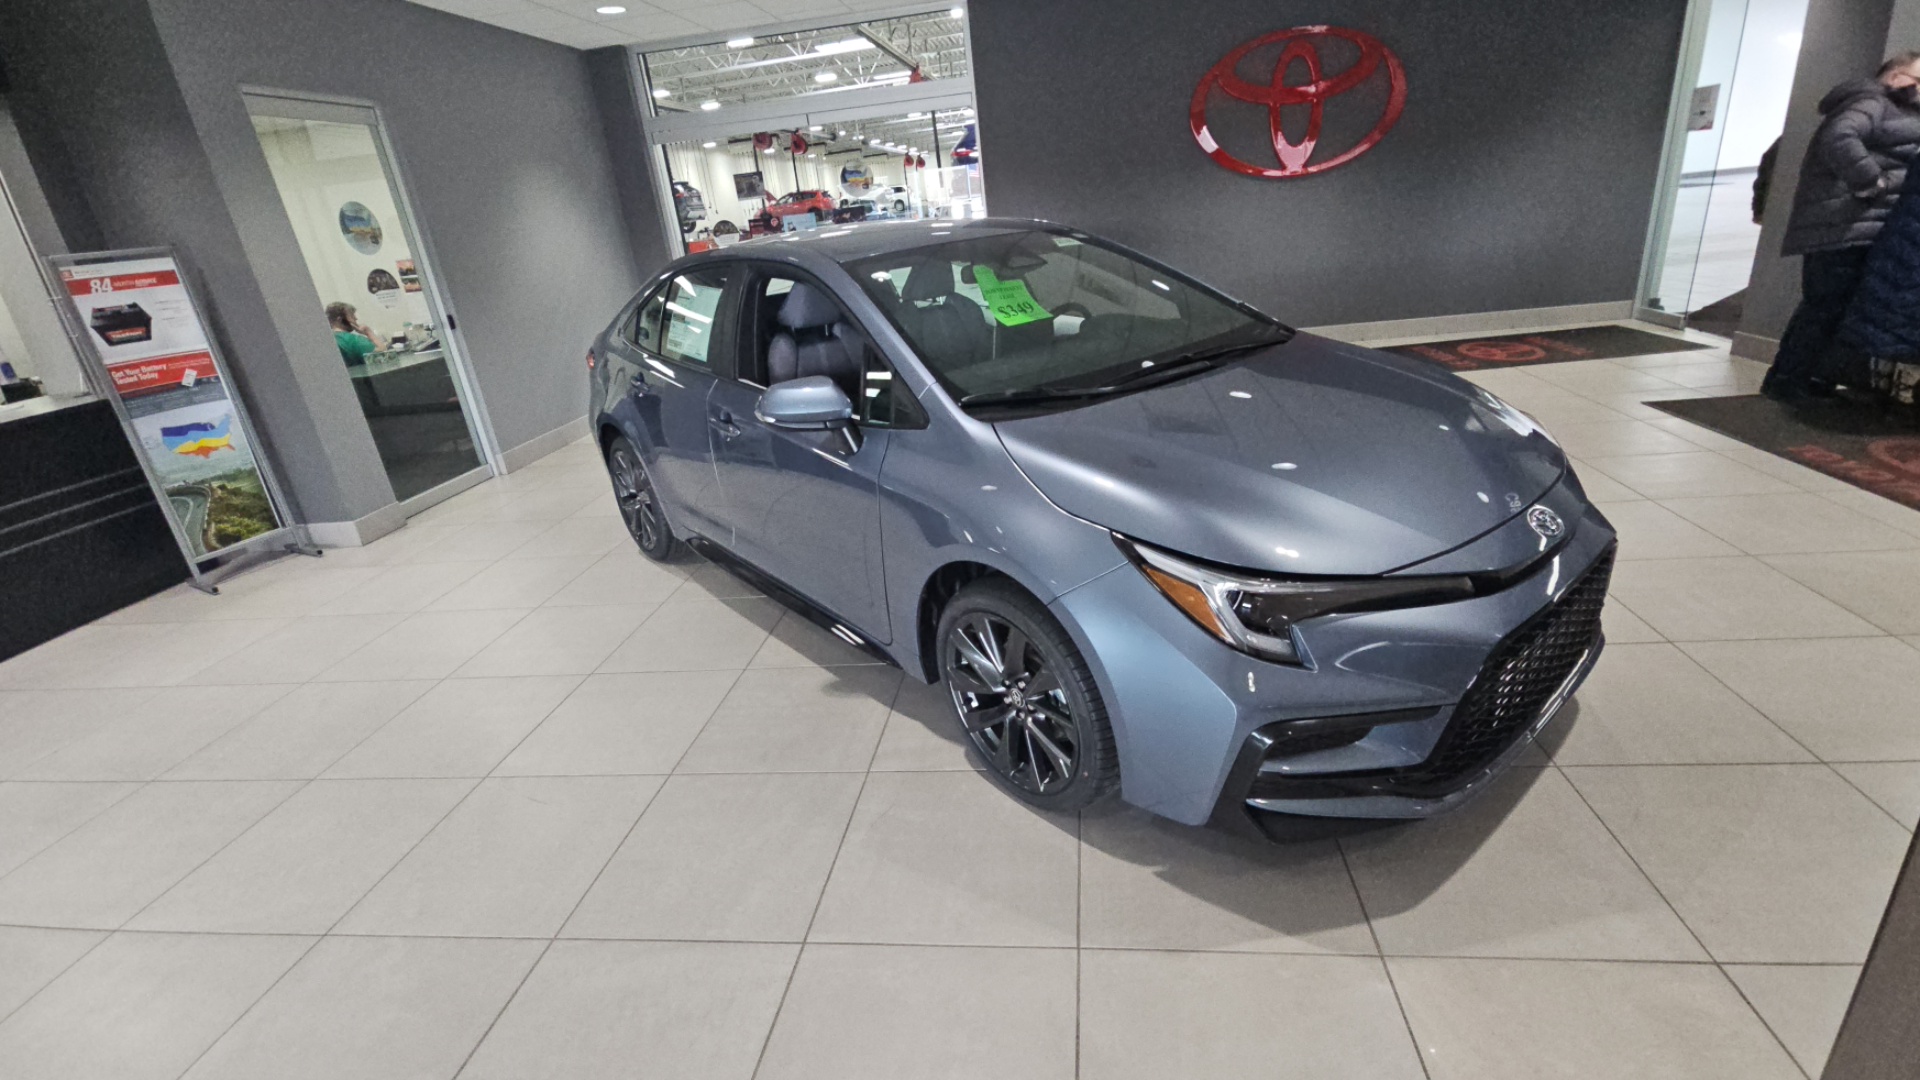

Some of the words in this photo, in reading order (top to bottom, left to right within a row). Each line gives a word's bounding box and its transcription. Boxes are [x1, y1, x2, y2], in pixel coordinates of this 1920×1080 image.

[90, 278, 113, 295] 84
[997, 301, 1034, 318] $349
[140, 364, 167, 373] Battery
[138, 371, 158, 381] Today
